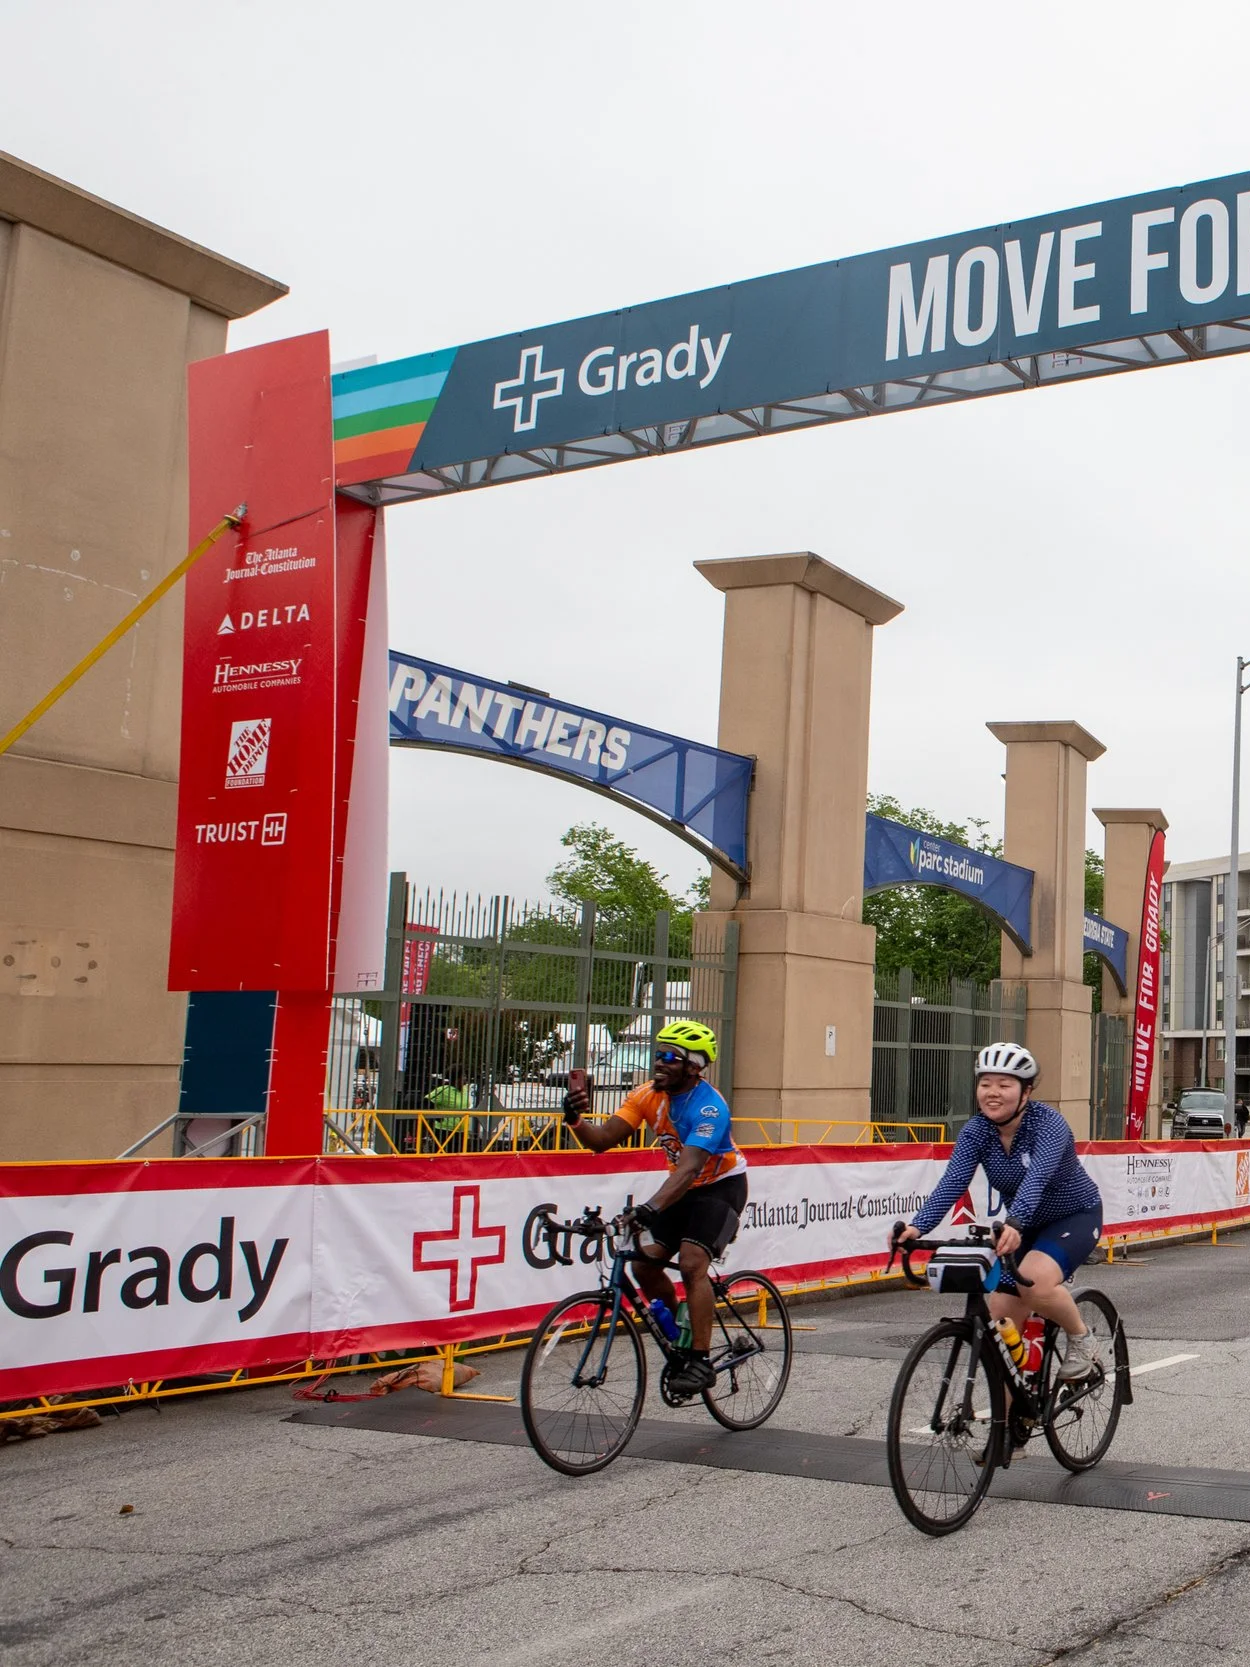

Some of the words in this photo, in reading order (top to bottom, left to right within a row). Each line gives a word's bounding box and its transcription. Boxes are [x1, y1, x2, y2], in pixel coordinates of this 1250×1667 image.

[885, 221, 1103, 361] MOVE
[578, 325, 732, 396] Grady
[245, 552, 263, 565] The
[263, 547, 298, 562] Atlanta
[223, 557, 316, 584] Journal-Constitution
[240, 603, 310, 630] DELTA
[212, 682, 258, 694] AUTOMOBILE
[260, 676, 301, 688] COMPANIES
[213, 658, 302, 685] HENNESSY
[389, 663, 631, 771] PANTHERS
[227, 719, 271, 776] HOME
[234, 726, 252, 748] THE
[242, 739, 269, 774] DEPOT
[226, 776, 263, 787] FOUNDATION
[195, 821, 260, 844] TRUIST
[923, 840, 941, 853] center
[918, 849, 943, 873] parc
[943, 855, 984, 885] stadium
[1145, 870, 1161, 953] GRADY
[1084, 917, 1101, 942] EORGIA
[1127, 1155, 1173, 1175] HENNESSY
[743, 1201, 798, 1231] Atlanta
[797, 1193, 929, 1231] Journal-Constitution
[522, 1194, 640, 1270] Gra
[0, 1216, 289, 1322] Grady
